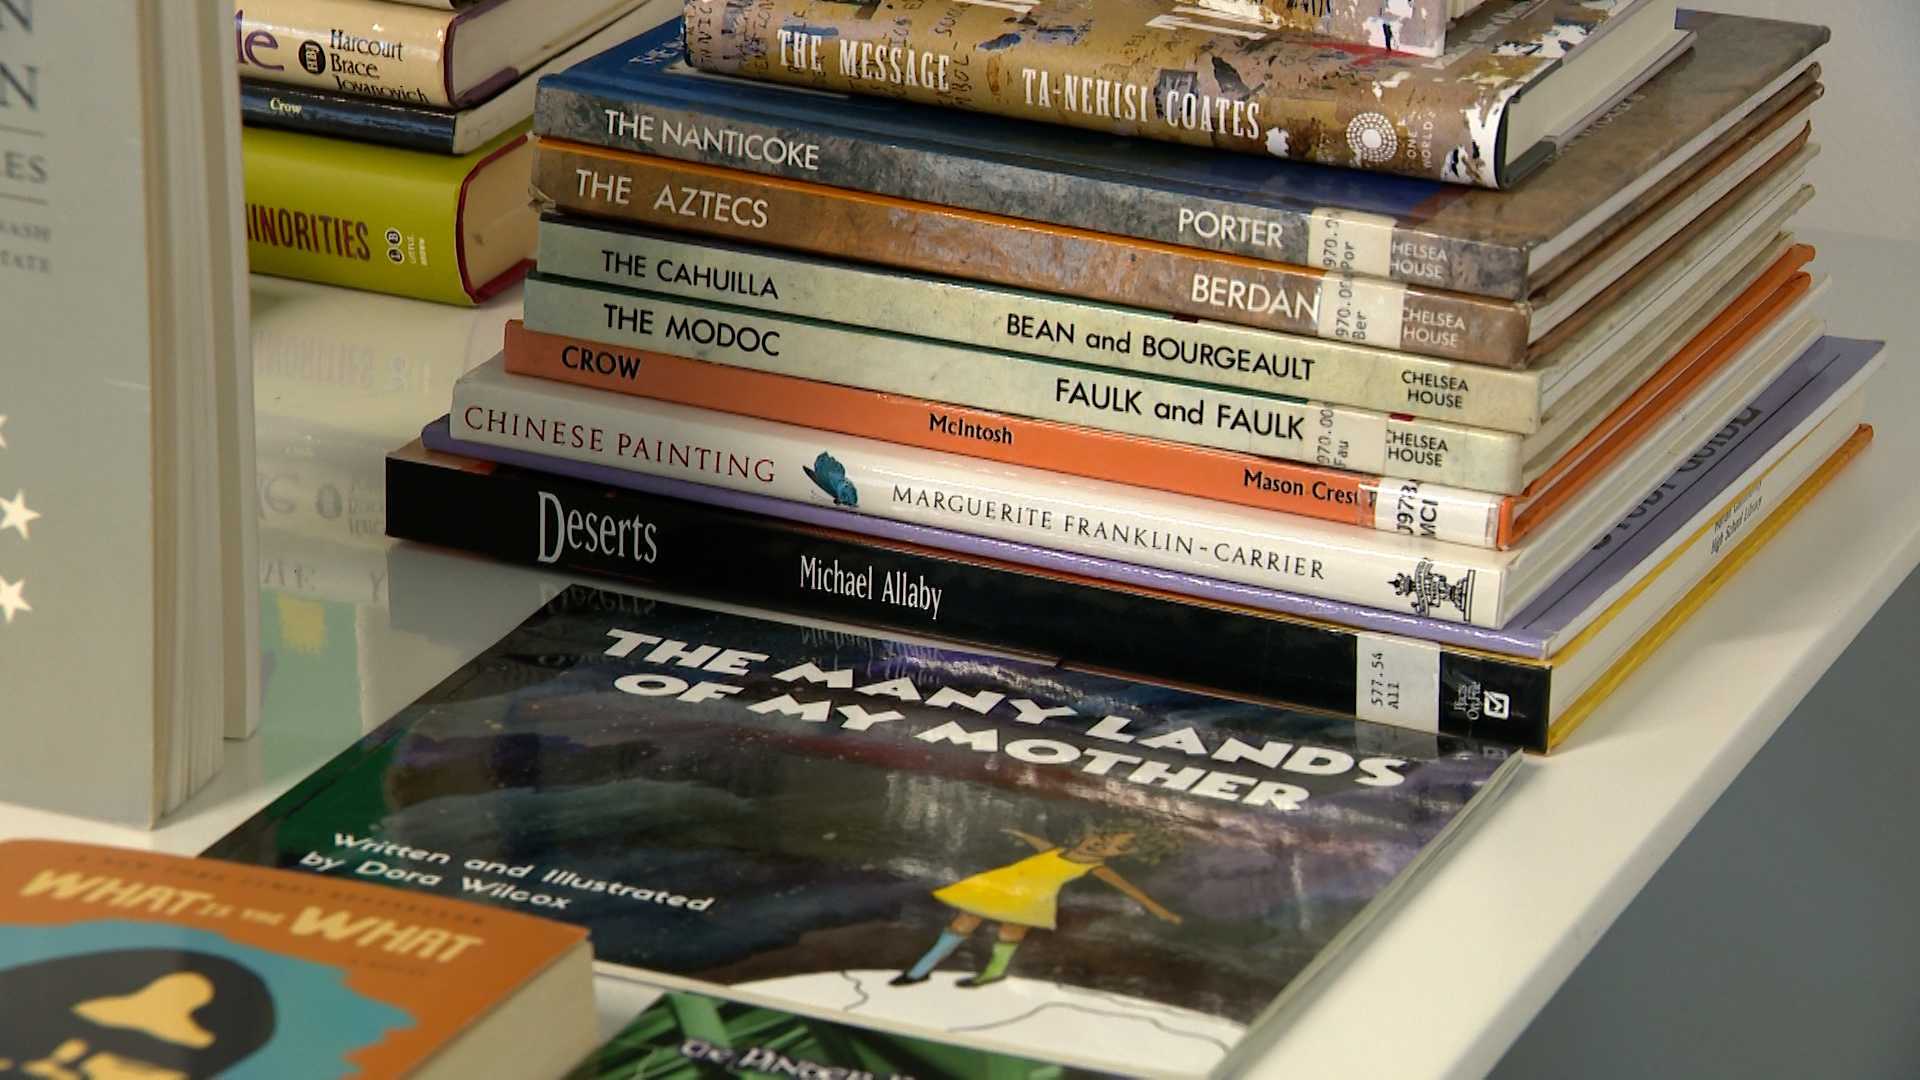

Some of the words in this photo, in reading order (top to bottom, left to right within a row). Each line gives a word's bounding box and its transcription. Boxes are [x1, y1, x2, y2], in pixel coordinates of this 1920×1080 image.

[330, 28, 404, 62] Harcourt
[330, 53, 380, 79] Brace
[777, 29, 823, 71] THE
[839, 38, 951, 91] MESSAGE
[270, 97, 302, 114] Crow
[1022, 67, 1148, 123] TA-NEHISI
[1166, 90, 1260, 140] COATES
[604, 108, 655, 142] THE
[661, 119, 820, 171] NANTICOKE
[1407, 130, 1418, 159] ONE
[1421, 120, 1434, 168] WORLD
[576, 168, 633, 204] THE
[654, 186, 770, 229] AZTECS
[1178, 207, 1284, 249] PORTER
[1391, 241, 1449, 263] HELSEA
[601, 250, 647, 279] THE
[656, 258, 779, 300] CAHUILLA
[1390, 257, 1443, 279] HOUSE
[1191, 273, 1323, 326] BERDAN
[603, 303, 654, 335] THE
[665, 315, 781, 357] MODOC
[1006, 313, 1075, 344] BEAN
[1086, 331, 1131, 354] and
[1142, 335, 1316, 381] BOURGEAULT
[1352, 310, 1368, 340] Ber
[1403, 325, 1459, 348] HOUSE
[561, 345, 642, 381] CROW
[1401, 369, 1469, 392] CHELSEA
[1056, 378, 1143, 415] FAULK
[1154, 400, 1204, 425] and
[1217, 404, 1306, 441] FAULK
[1407, 388, 1464, 409] HOUSE
[464, 406, 604, 452] CHINESE
[617, 431, 777, 484] PAINTING
[929, 412, 1014, 446] McIntosh
[1333, 440, 1349, 469] Fau
[1387, 447, 1444, 467] HOUSE
[1243, 468, 1305, 496] Mason
[537, 490, 658, 565] Deserts
[892, 484, 1053, 531] MARGUERITE
[800, 554, 873, 600] Michael
[881, 570, 942, 620] Allaby
[605, 628, 770, 676] THE
[771, 661, 1078, 725] MANY
[1085, 714, 1407, 787] LANDS
[613, 673, 745, 703] OF
[745, 693, 906, 732] MY
[913, 720, 1311, 811] MOTHER
[300, 850, 345, 872] by
[355, 860, 442, 887] Dora
[461, 876, 573, 911] Wilcox
[334, 833, 452, 865] Written
[464, 857, 536, 879] and
[542, 867, 717, 913] Illustrated
[20, 870, 212, 916] WHAT
[290, 905, 486, 963] WHAT
